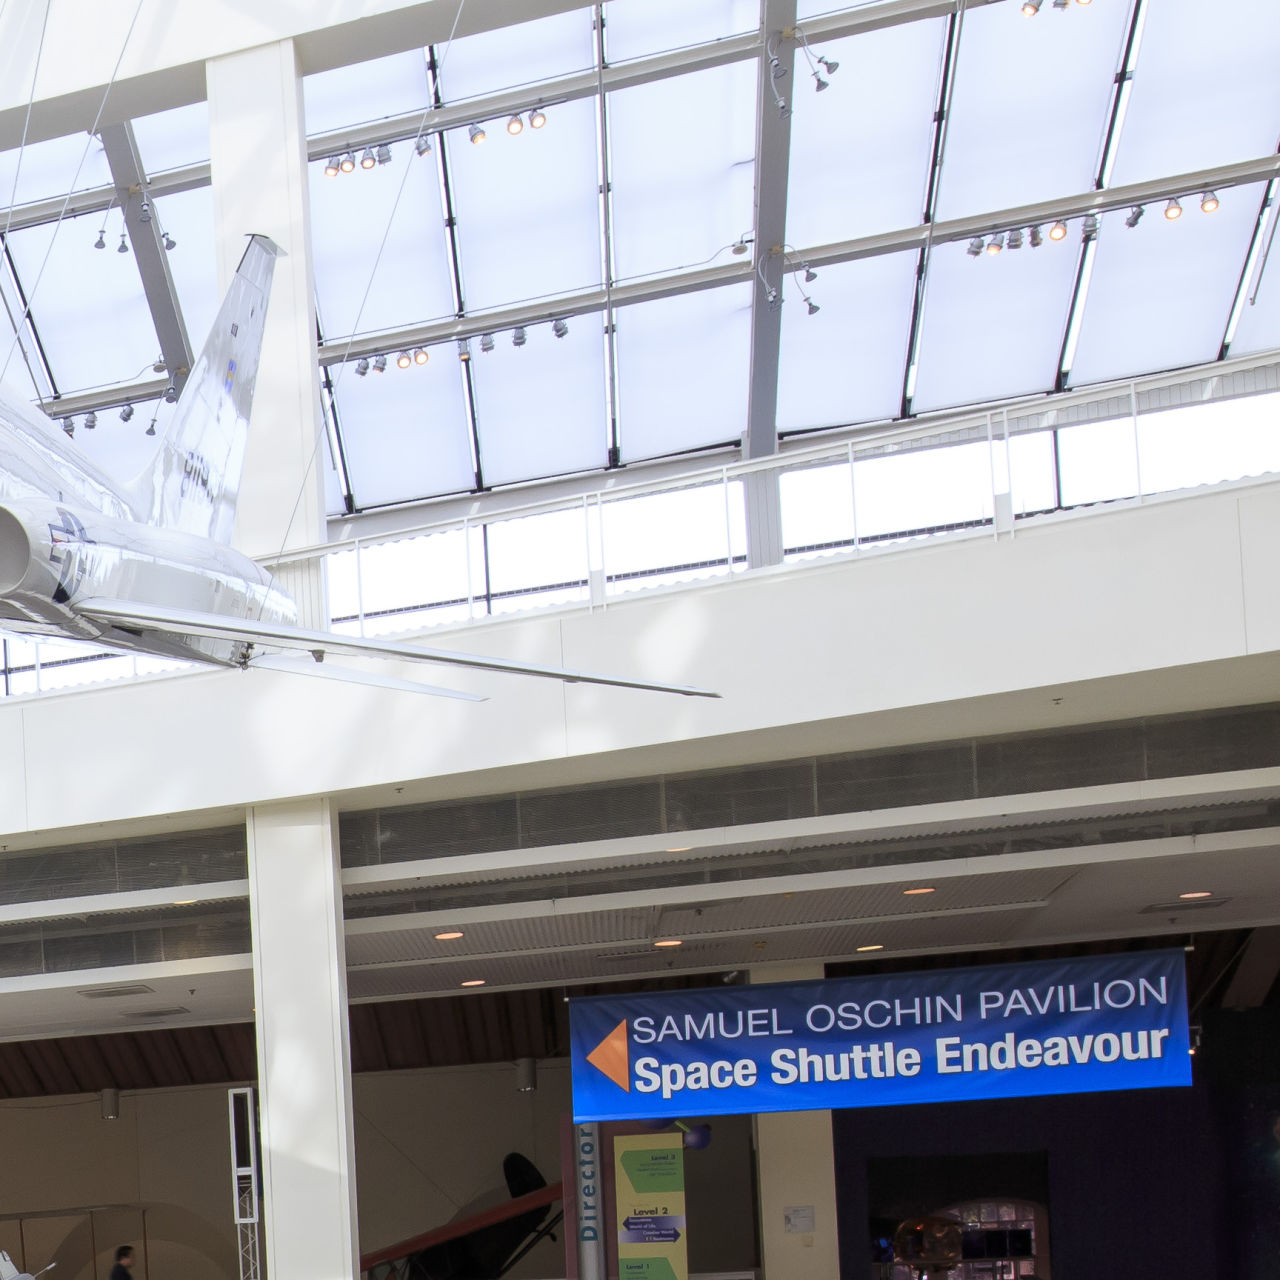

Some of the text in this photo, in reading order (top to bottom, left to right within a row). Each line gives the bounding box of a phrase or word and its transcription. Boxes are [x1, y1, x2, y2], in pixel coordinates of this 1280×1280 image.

[632, 976, 1168, 1044] SAMUEL OSCHIN PAVILION
[634, 1028, 1169, 1100] Space Shuttle Endeavour
[633, 1206, 669, 1216] Level 2
